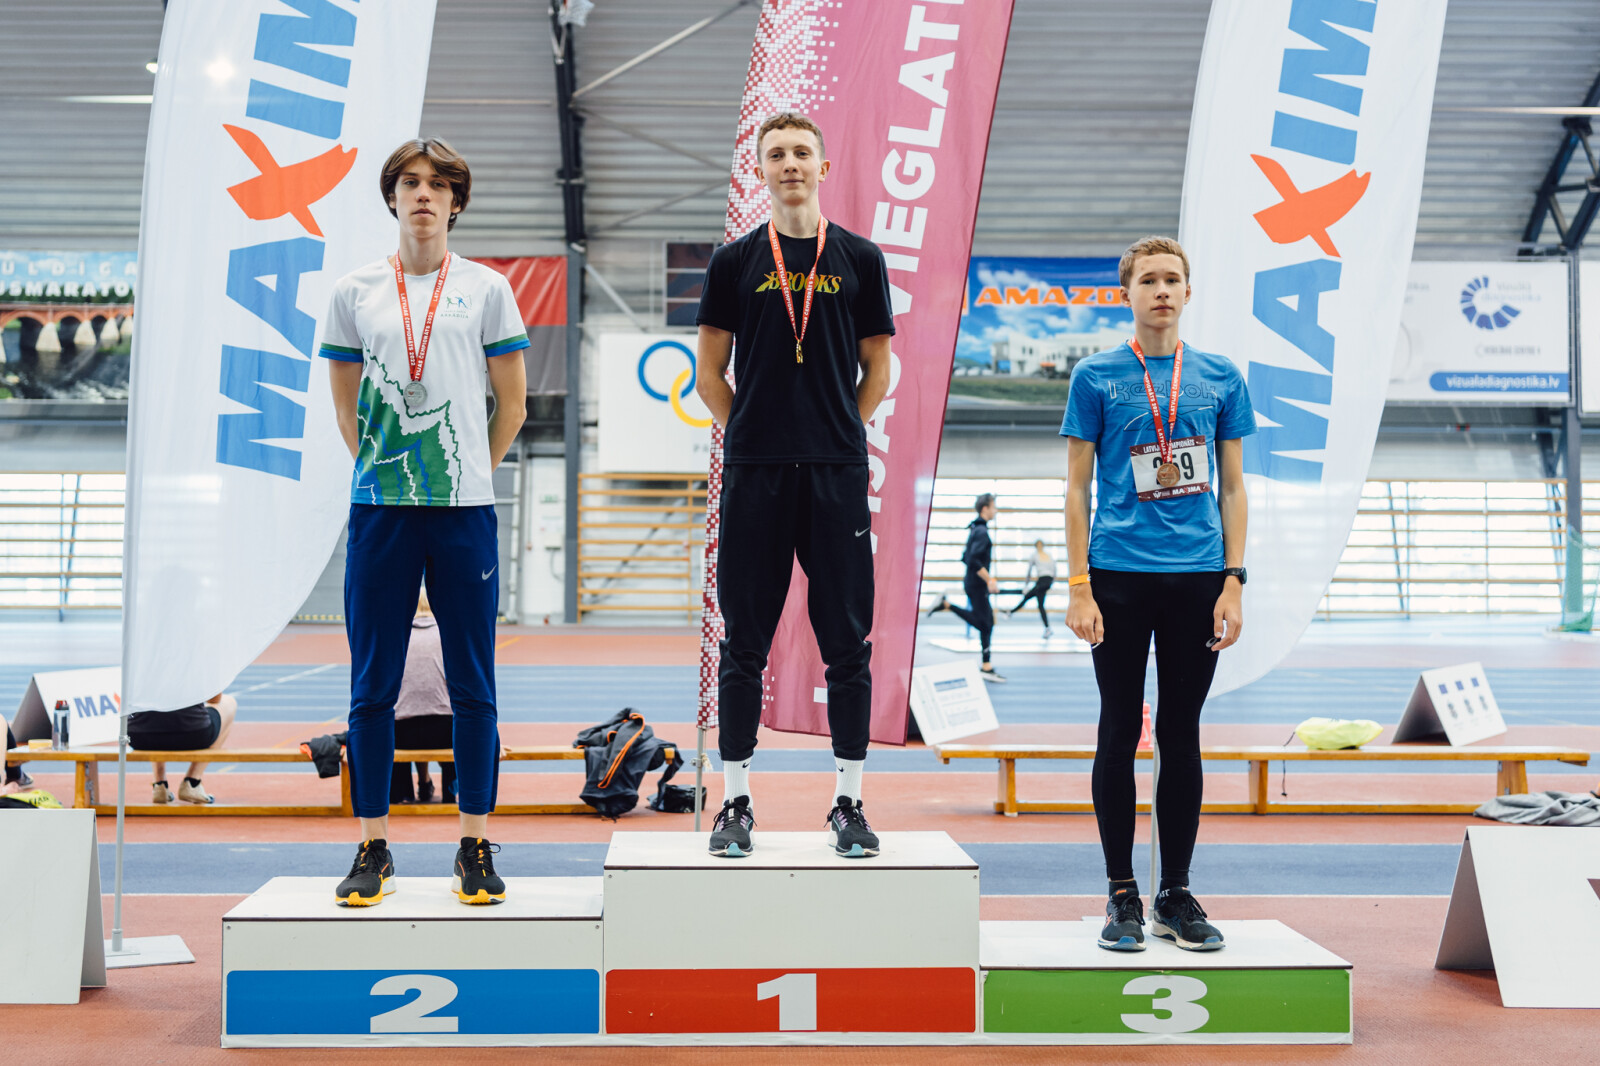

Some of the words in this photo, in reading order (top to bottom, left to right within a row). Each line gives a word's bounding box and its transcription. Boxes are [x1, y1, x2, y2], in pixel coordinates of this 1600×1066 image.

[871, 0, 964, 316] IEGLAT
[216, 0, 360, 481] MAXIM
[1242, 0, 1378, 488] MAXIM
[0, 281, 137, 297] SMARATO
[414, 360, 423, 380] TVIJAS
[1446, 375, 1560, 391] vizualadiagnostika.lv
[1143, 444, 1160, 454] LATVIJ
[1171, 438, 1195, 449] MPIONĀTS
[369, 974, 459, 1033] 2
[756, 972, 817, 1031] 1
[1120, 974, 1210, 1034] 3
